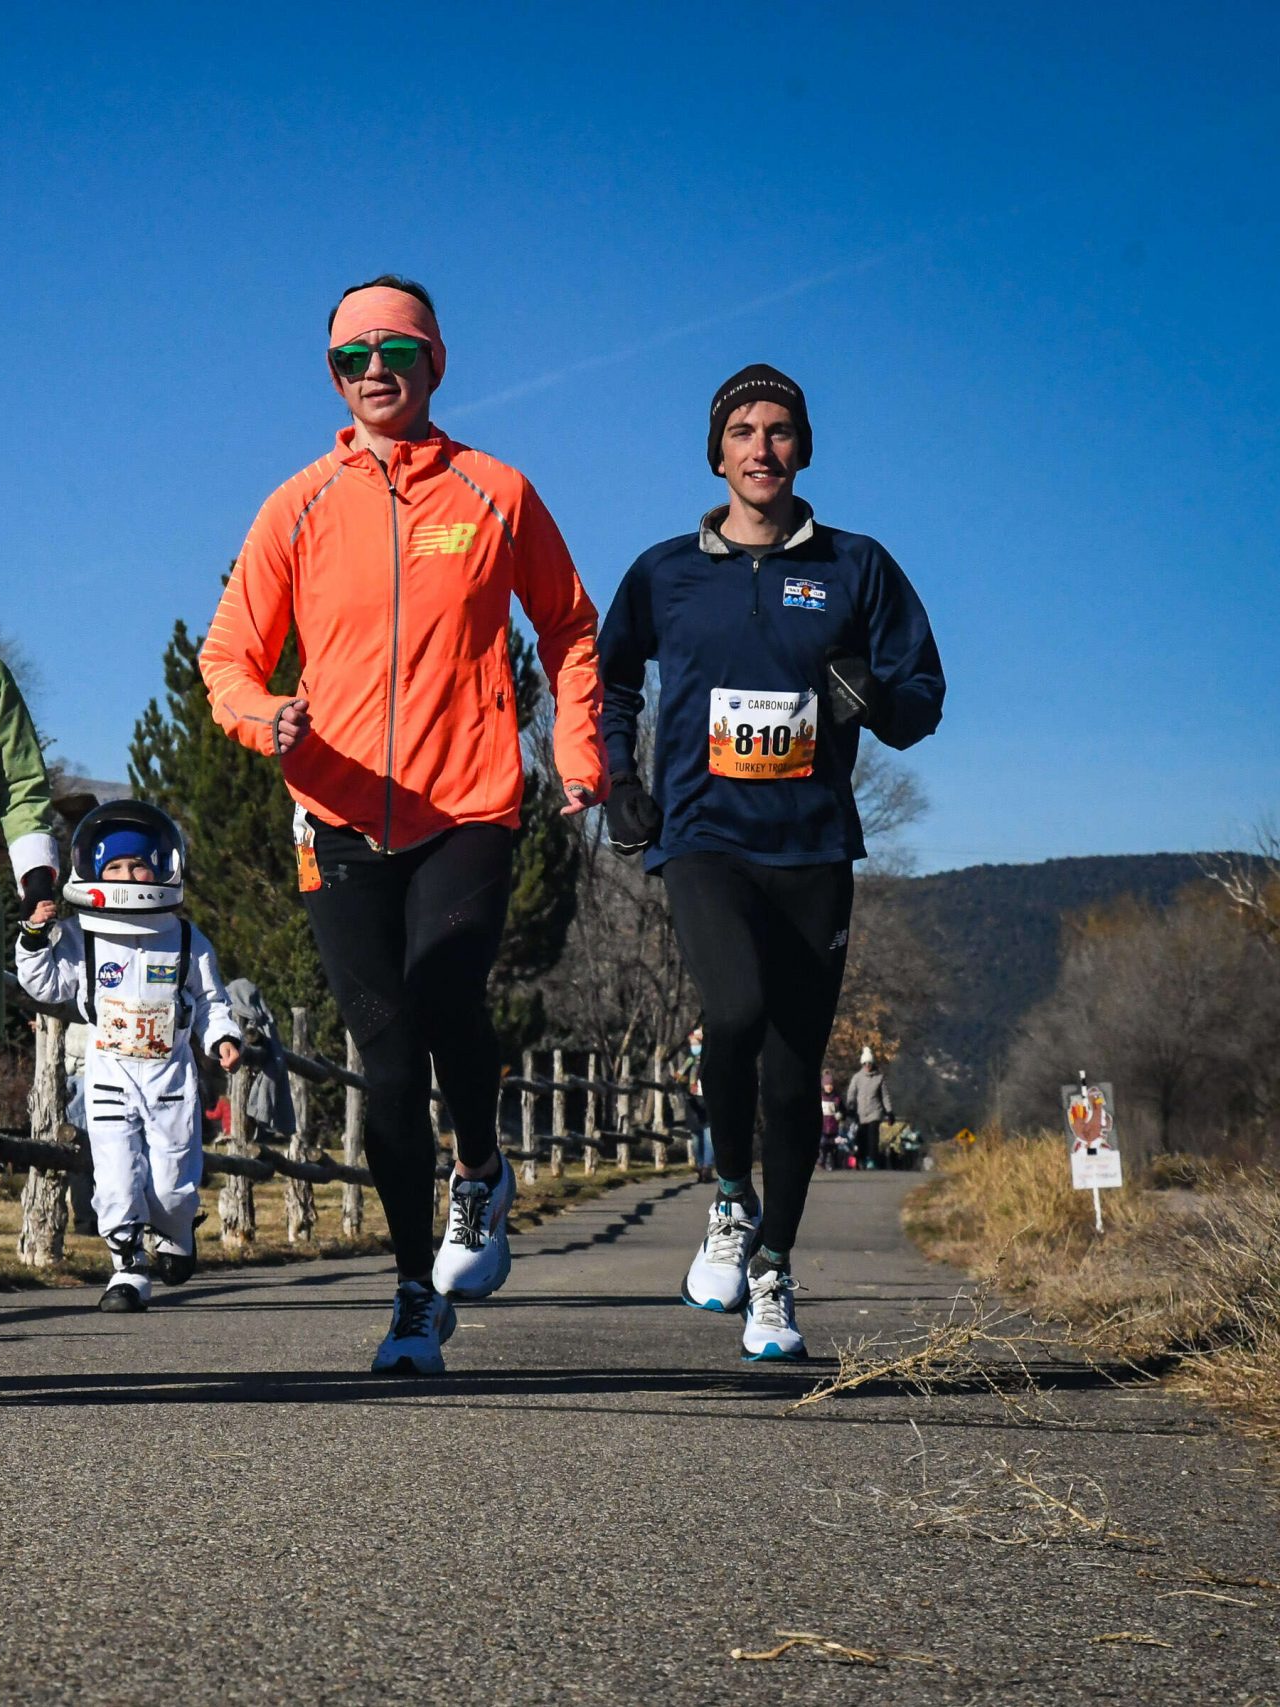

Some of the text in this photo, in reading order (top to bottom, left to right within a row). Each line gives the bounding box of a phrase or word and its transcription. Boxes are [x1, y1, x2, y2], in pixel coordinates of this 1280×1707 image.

[748, 699, 797, 711] CARBONDAL
[735, 723, 791, 756] 810
[735, 762, 785, 773] TURKEY TRO
[100, 971, 123, 981] NASA
[136, 1017, 156, 1041] 51
